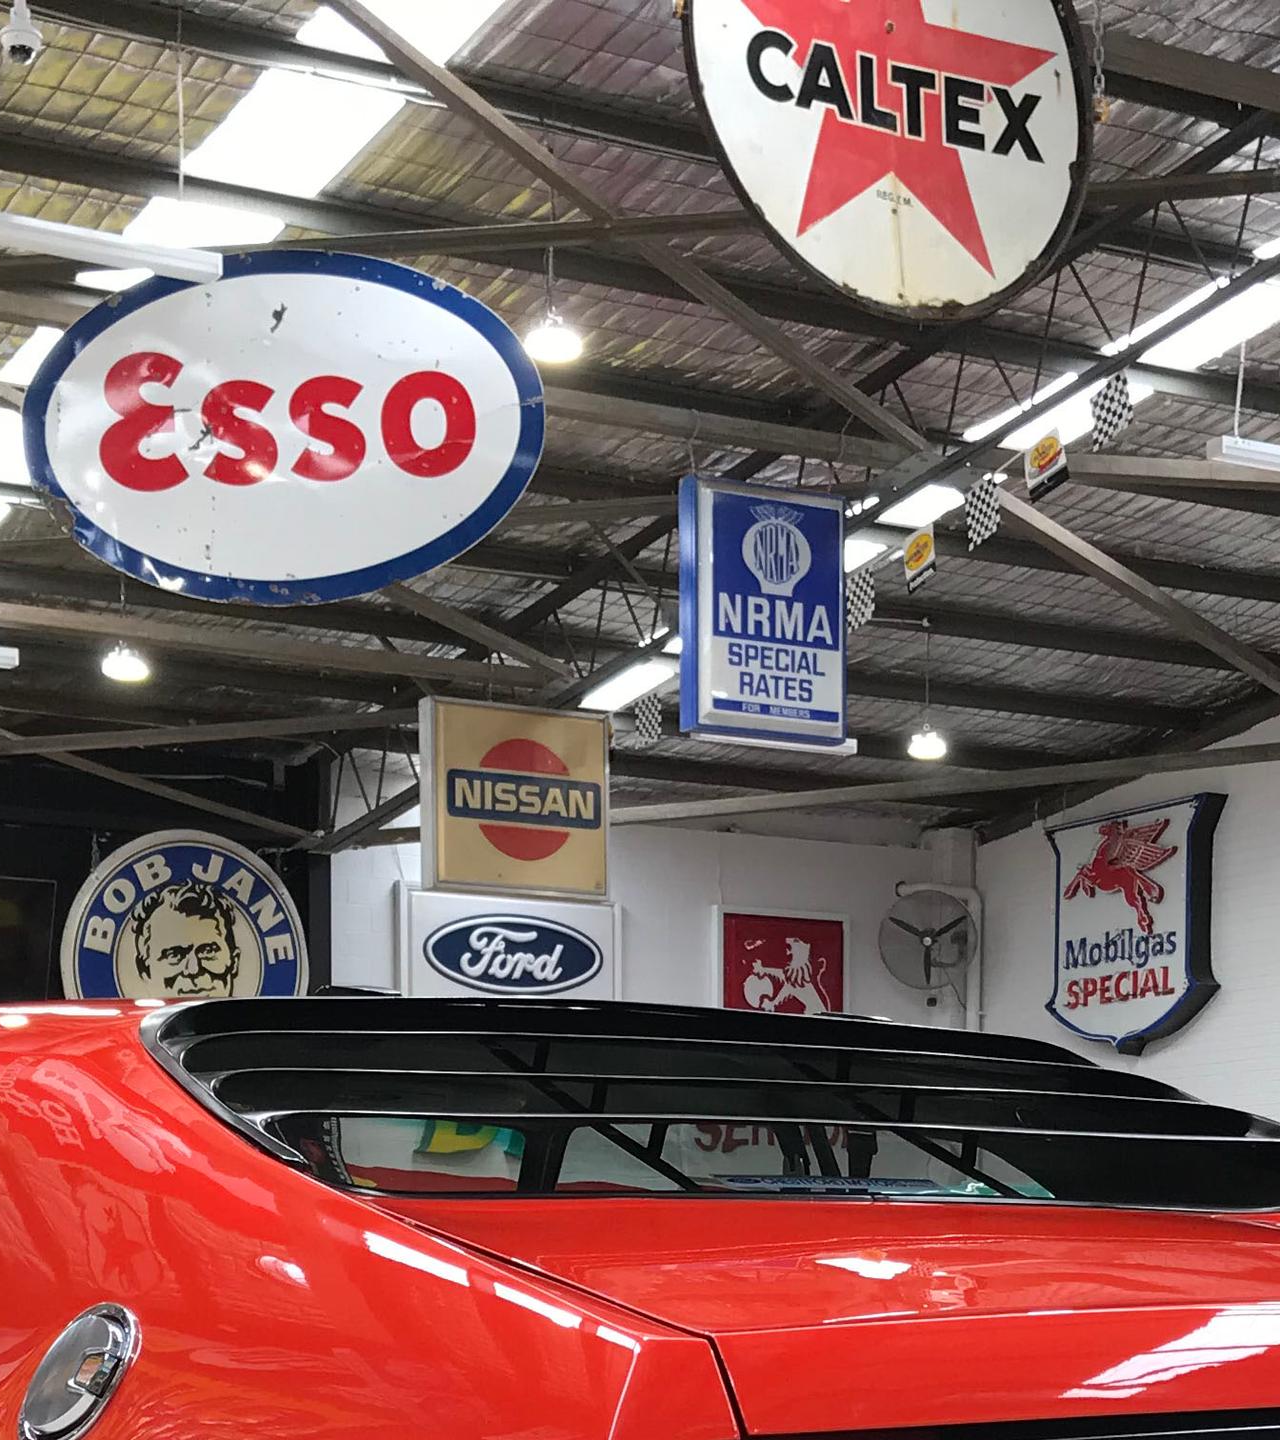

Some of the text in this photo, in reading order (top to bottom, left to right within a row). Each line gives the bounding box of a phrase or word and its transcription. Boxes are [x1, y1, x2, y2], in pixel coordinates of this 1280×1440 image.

[746, 30, 1045, 164] CALTEX
[718, 592, 833, 645] NRMA
[728, 643, 826, 677] SPECIAL
[739, 671, 813, 703] RATES
[742, 703, 811, 719] FOR MEMBERS
[454, 777, 594, 820] NISSAN
[83, 853, 295, 965] BOB JANE
[459, 926, 563, 982] Ford
[1063, 929, 1177, 969] Mobilgas
[1063, 967, 1175, 1009] SPECIAL
